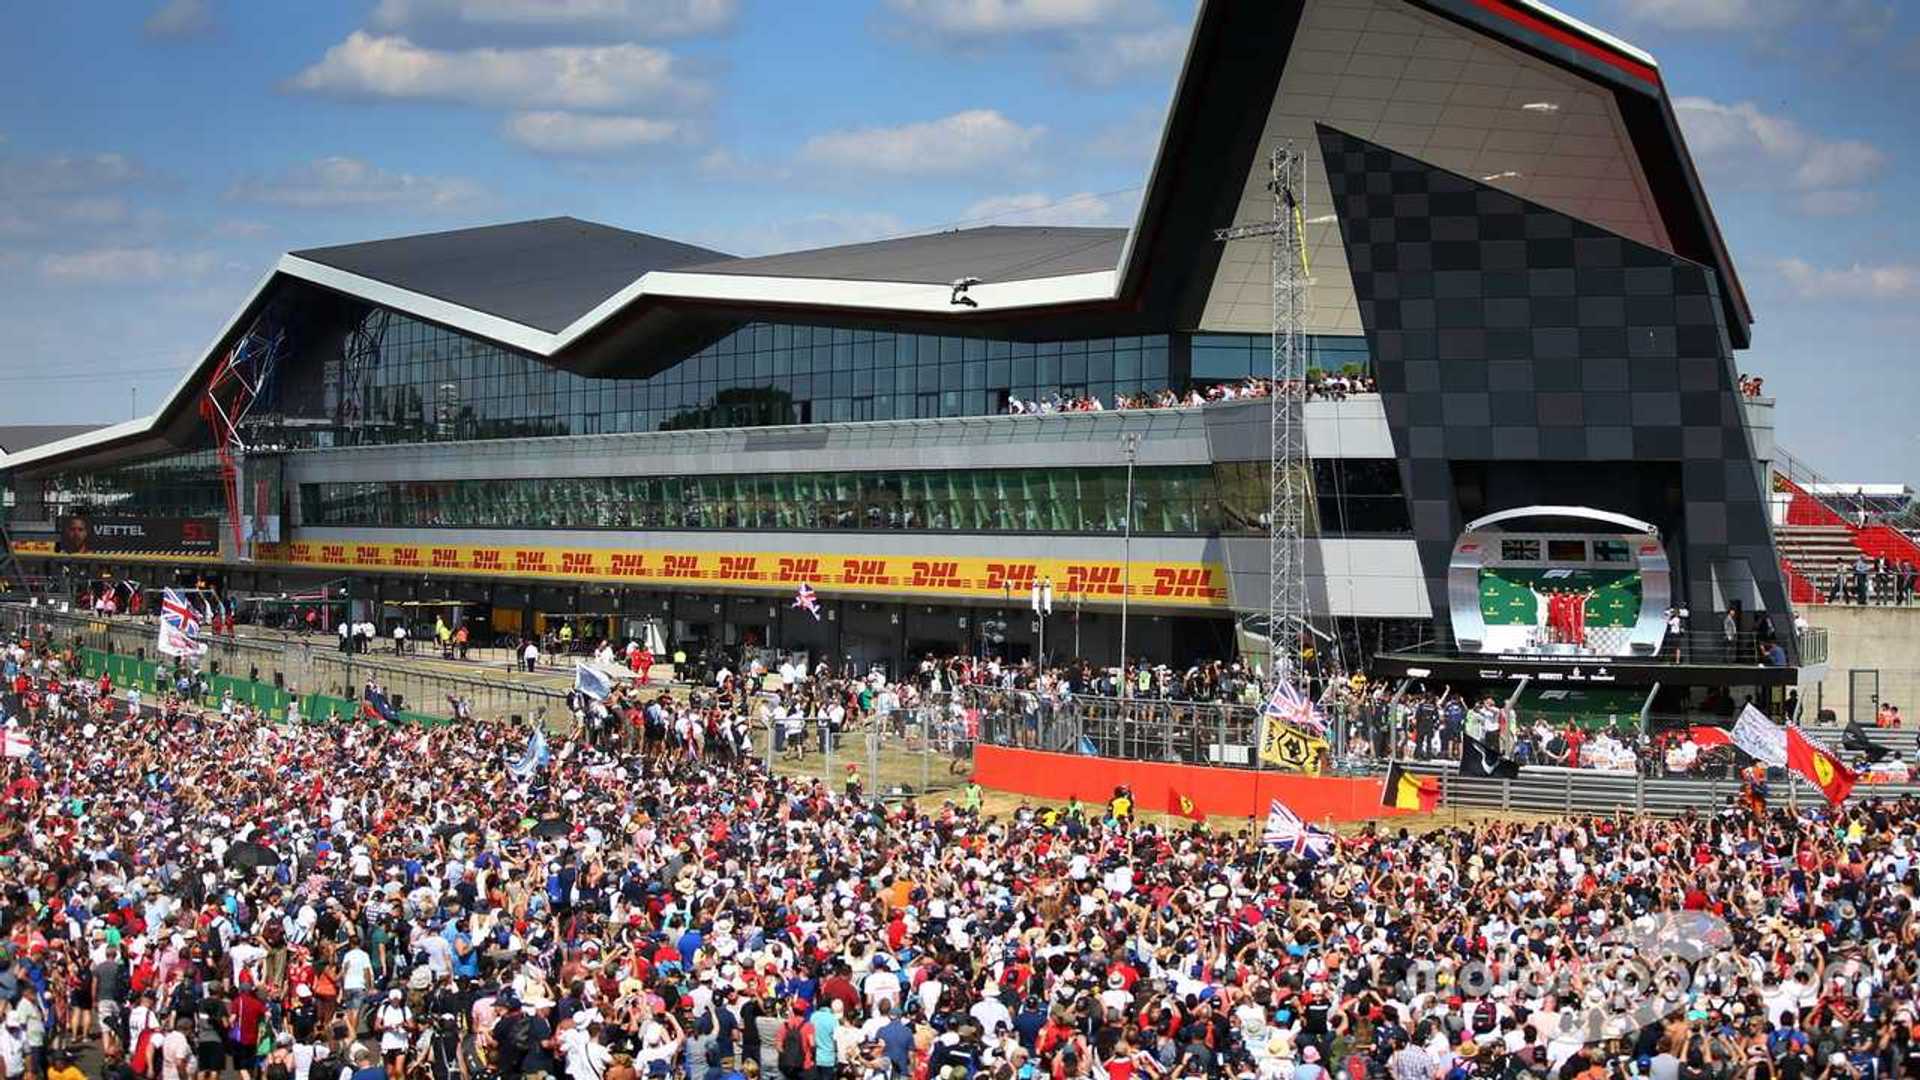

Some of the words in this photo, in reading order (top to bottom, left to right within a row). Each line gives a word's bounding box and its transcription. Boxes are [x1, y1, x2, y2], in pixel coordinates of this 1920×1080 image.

[94, 525, 145, 536] VETTEL
[393, 548, 419, 565] DHL
[431, 549, 459, 567] DHL
[472, 550, 502, 569] DHL
[516, 551, 549, 571] DHL
[562, 553, 594, 573] DHL
[611, 554, 649, 576] DHL
[663, 555, 701, 577] DHL
[719, 557, 759, 580] DHL
[778, 558, 824, 583] DHL
[843, 560, 889, 585] DHL
[911, 562, 961, 588] DHL
[986, 564, 1037, 590] DHL
[1066, 566, 1130, 594] DHL
[1152, 568, 1216, 597] DHL
